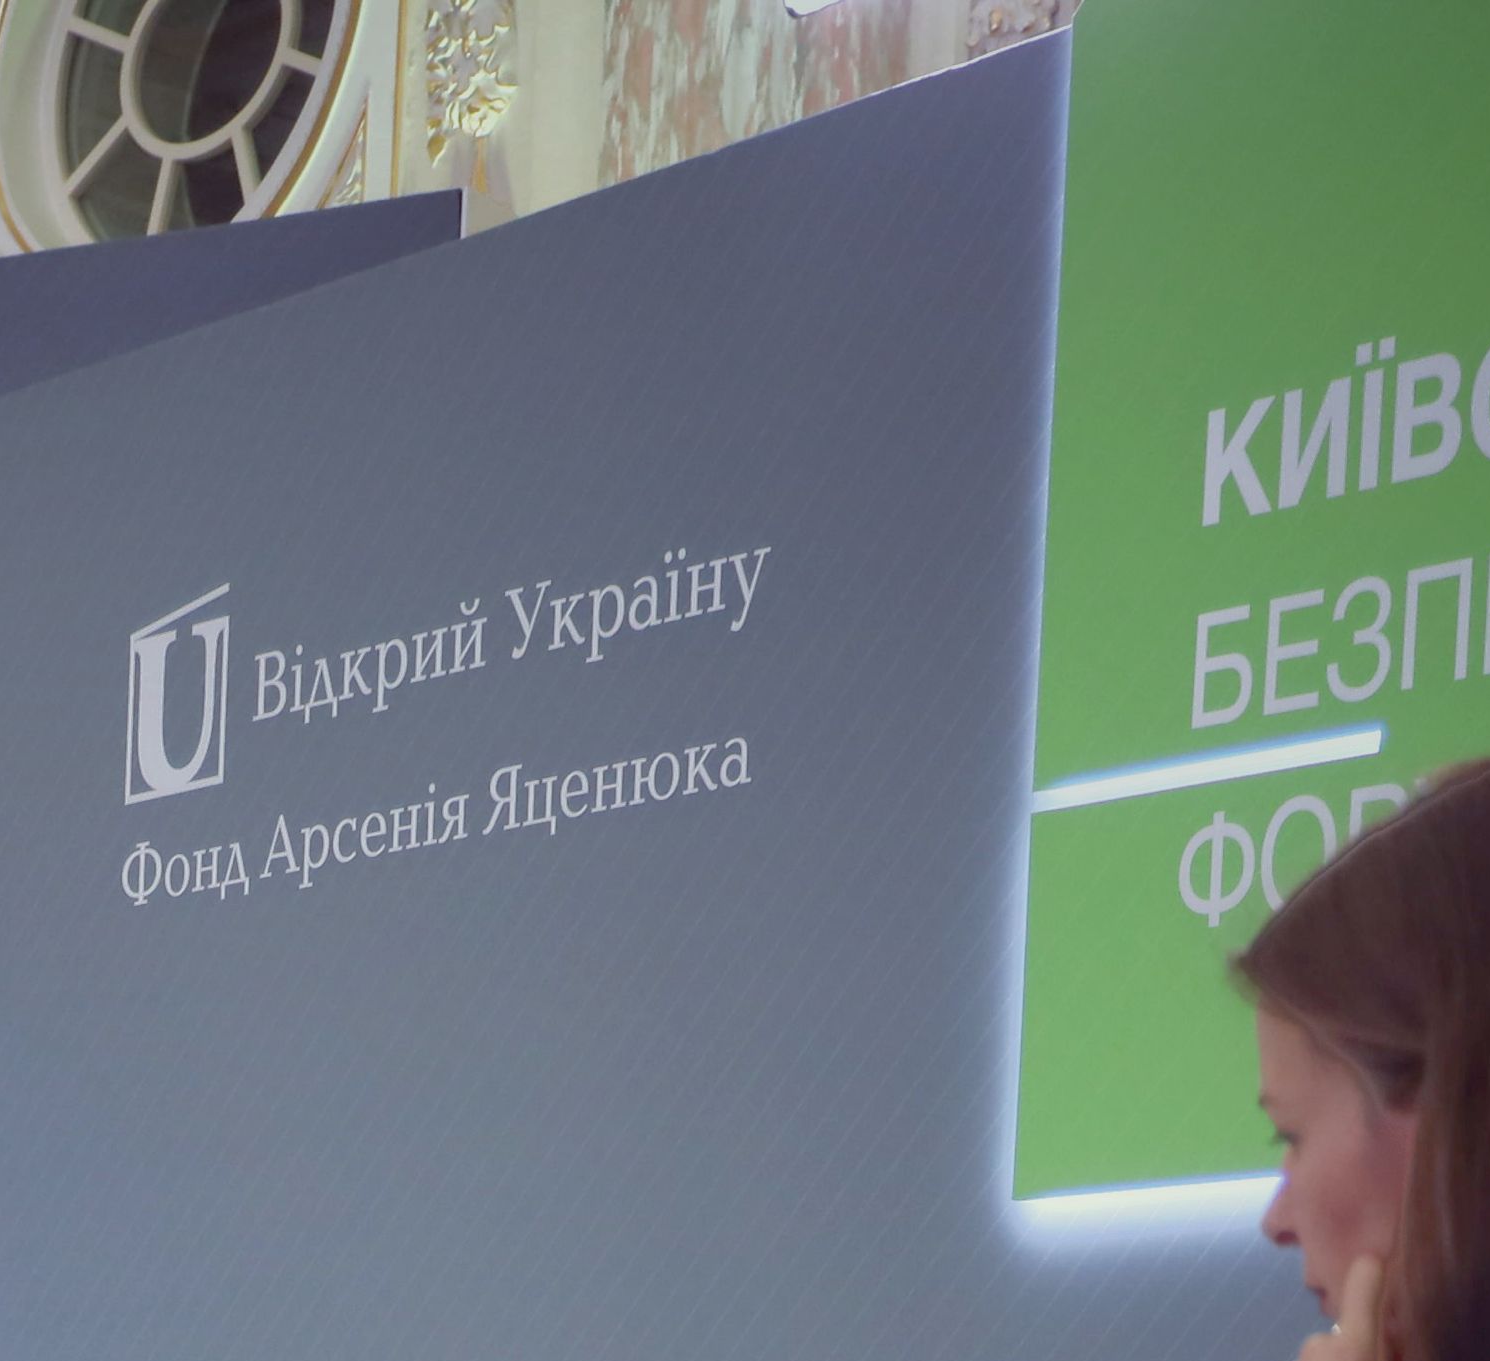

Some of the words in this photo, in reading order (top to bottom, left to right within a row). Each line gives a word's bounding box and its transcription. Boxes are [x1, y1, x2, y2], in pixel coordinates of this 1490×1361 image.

[252, 599, 488, 725] Відкрий
[504, 545, 773, 663] Україну
[121, 841, 250, 907] Фонд
[259, 782, 470, 888] Арсенія
[481, 735, 752, 836] Яценюка
